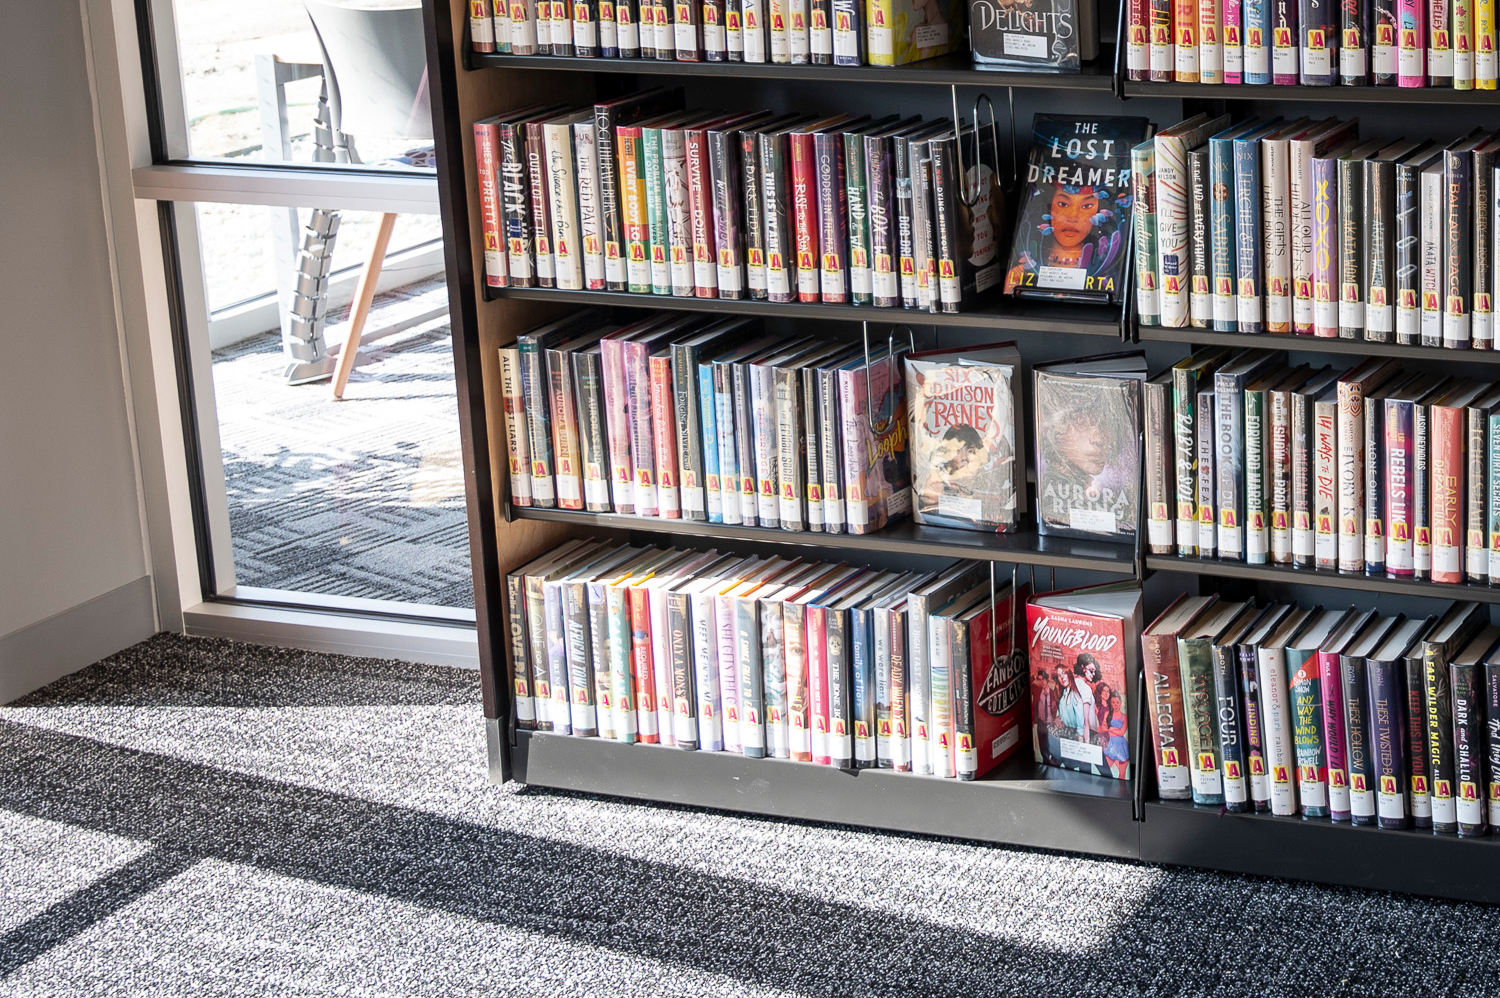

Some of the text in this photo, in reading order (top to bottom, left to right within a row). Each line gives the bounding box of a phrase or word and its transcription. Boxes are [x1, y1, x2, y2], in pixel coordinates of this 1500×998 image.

[972, 1, 1072, 38] DELIGHTS
[1075, 123, 1098, 134] THE
[1052, 138, 1114, 160] LOST
[1027, 165, 1132, 187] DREAMER
[1315, 180, 1329, 271] XOXO
[1009, 272, 1033, 285] LIZ
[924, 382, 993, 403] CRIMSON
[924, 402, 1001, 439] CRANES
[1044, 483, 1129, 506] AURORA
[1032, 617, 1117, 651] YOUNGBLOOD
[986, 653, 1027, 694] FANBOY
[988, 693, 1007, 711] GOTH
[1297, 696, 1313, 705] ANY
[1297, 706, 1314, 715] WAY
[1219, 696, 1236, 745] FOUR
[1299, 716, 1311, 725] THE
[1295, 736, 1319, 745] BLOWS
